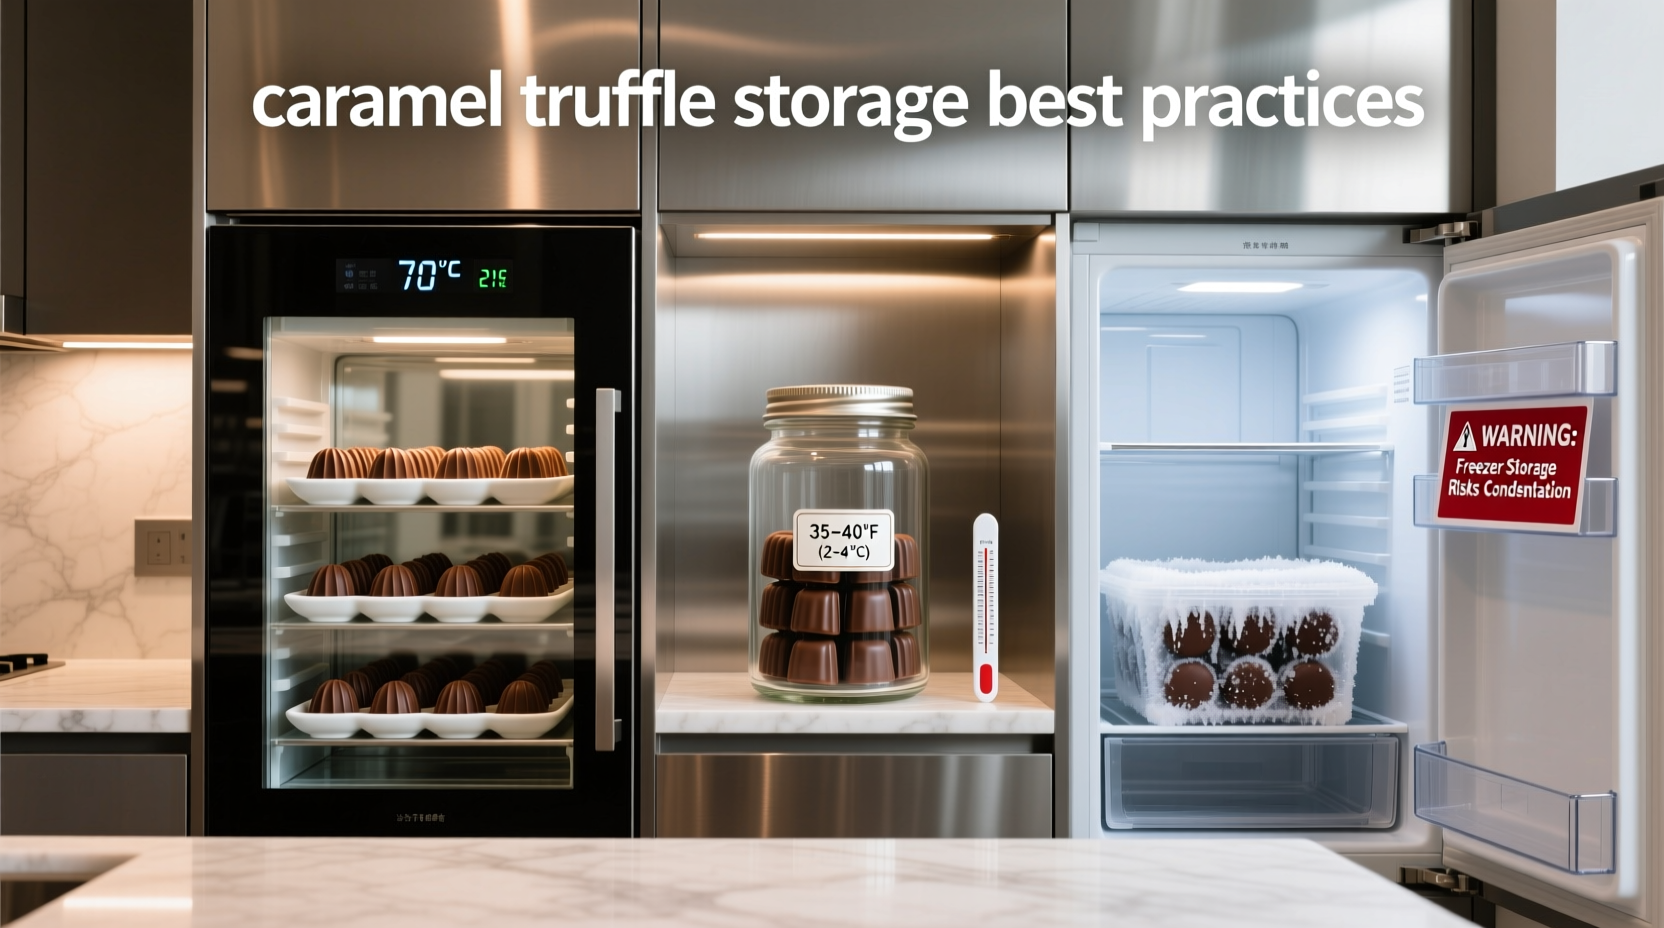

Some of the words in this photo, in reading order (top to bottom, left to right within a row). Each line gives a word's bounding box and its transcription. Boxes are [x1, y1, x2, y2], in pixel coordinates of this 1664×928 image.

[1481, 423, 1578, 447] WARNING:
[1455, 458, 1504, 475] Freezer
[1505, 458, 1557, 480] Storage
